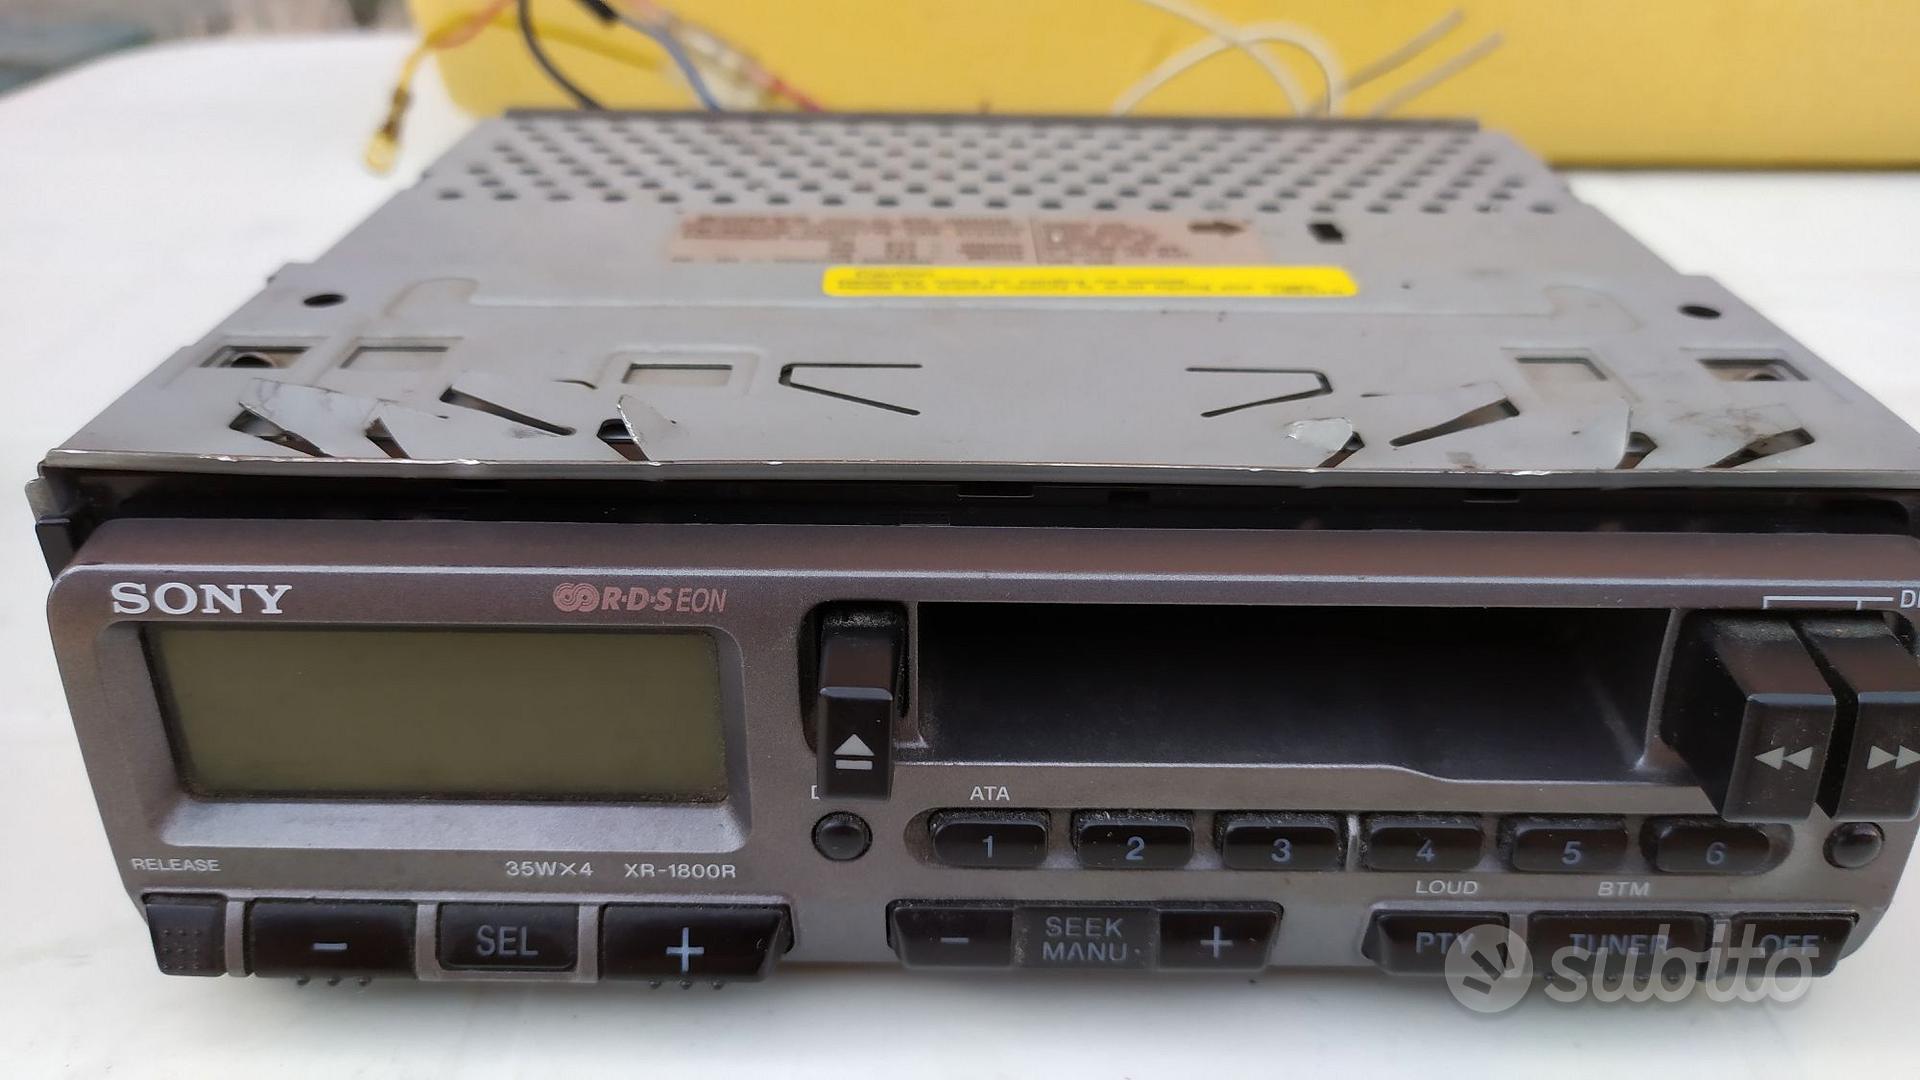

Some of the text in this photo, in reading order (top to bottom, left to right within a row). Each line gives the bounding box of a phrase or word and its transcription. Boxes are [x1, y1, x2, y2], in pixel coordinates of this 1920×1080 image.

[110, 581, 293, 616] SONY
[1900, 589, 1920, 609] D
[969, 785, 1010, 802] ATA
[982, 836, 994, 858] 1
[1126, 837, 1145, 860] 2
[1272, 838, 1292, 862] 3
[1416, 841, 1436, 863] 4
[1561, 841, 1583, 865] 5
[1705, 842, 1726, 866] 6
[131, 857, 221, 873] RELEASE
[624, 862, 738, 880] XR-1800R
[1415, 880, 1478, 895] LOUD
[1598, 880, 1650, 897] BTM
[1045, 916, 1124, 938] SEEK
[476, 924, 540, 958] SEL
[1042, 940, 1128, 962] MANU
[1415, 931, 1475, 955] PTY
[1569, 933, 1672, 956] TUNER
[1759, 934, 1820, 956] OFF
